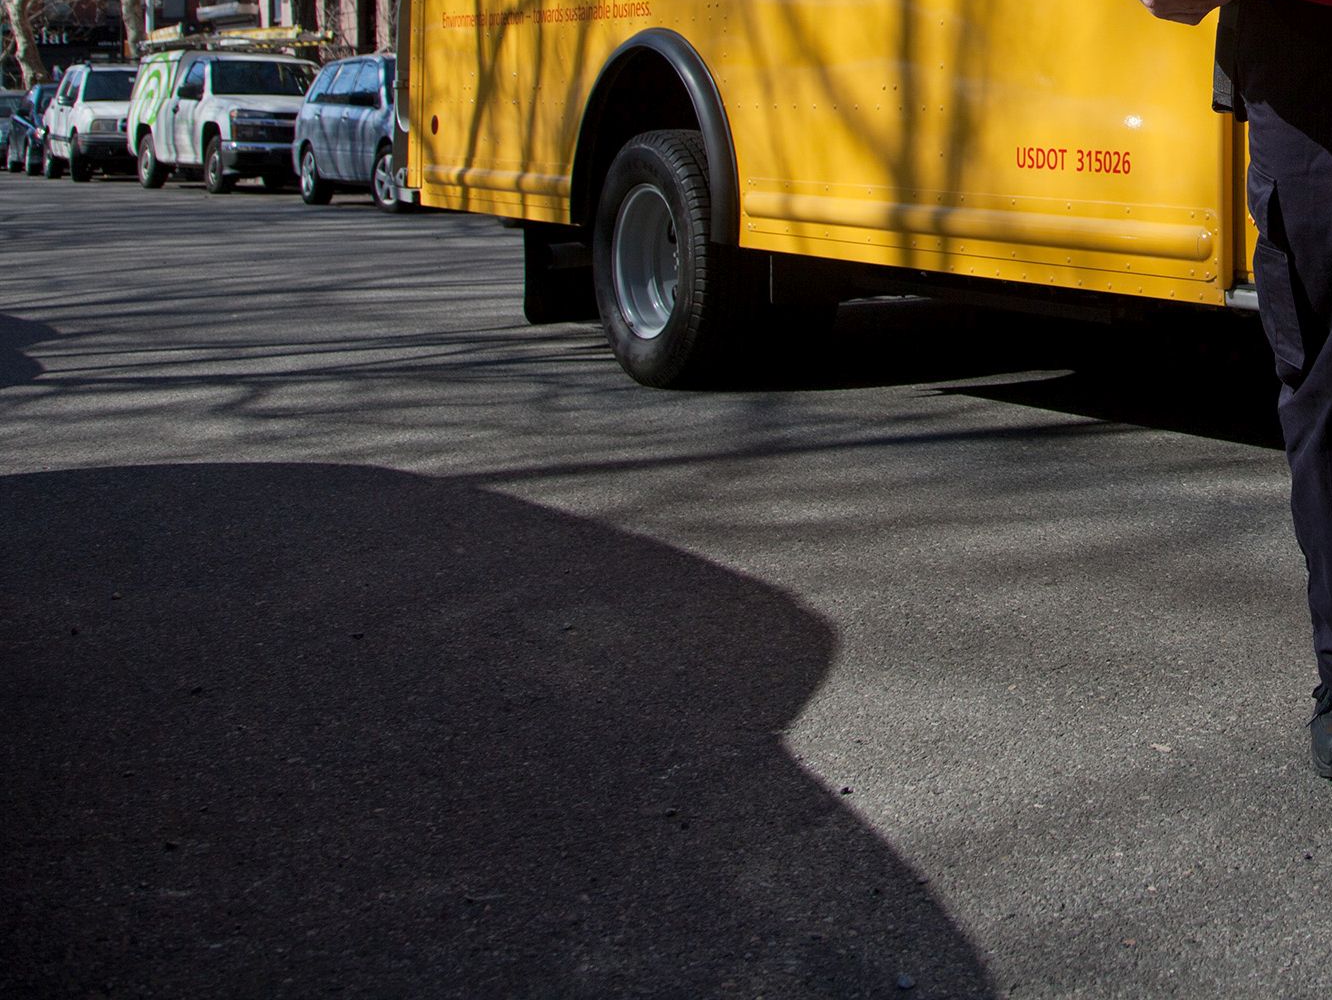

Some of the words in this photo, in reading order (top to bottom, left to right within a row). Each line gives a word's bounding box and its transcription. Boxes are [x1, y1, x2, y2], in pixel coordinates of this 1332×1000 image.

[442, 9, 488, 28] Environmental
[489, 9, 524, 28] protection
[533, 4, 564, 24] towards
[565, 0, 610, 22] sustainable
[1016, 146, 1068, 171] USDOT
[1076, 149, 1131, 175] 315026
